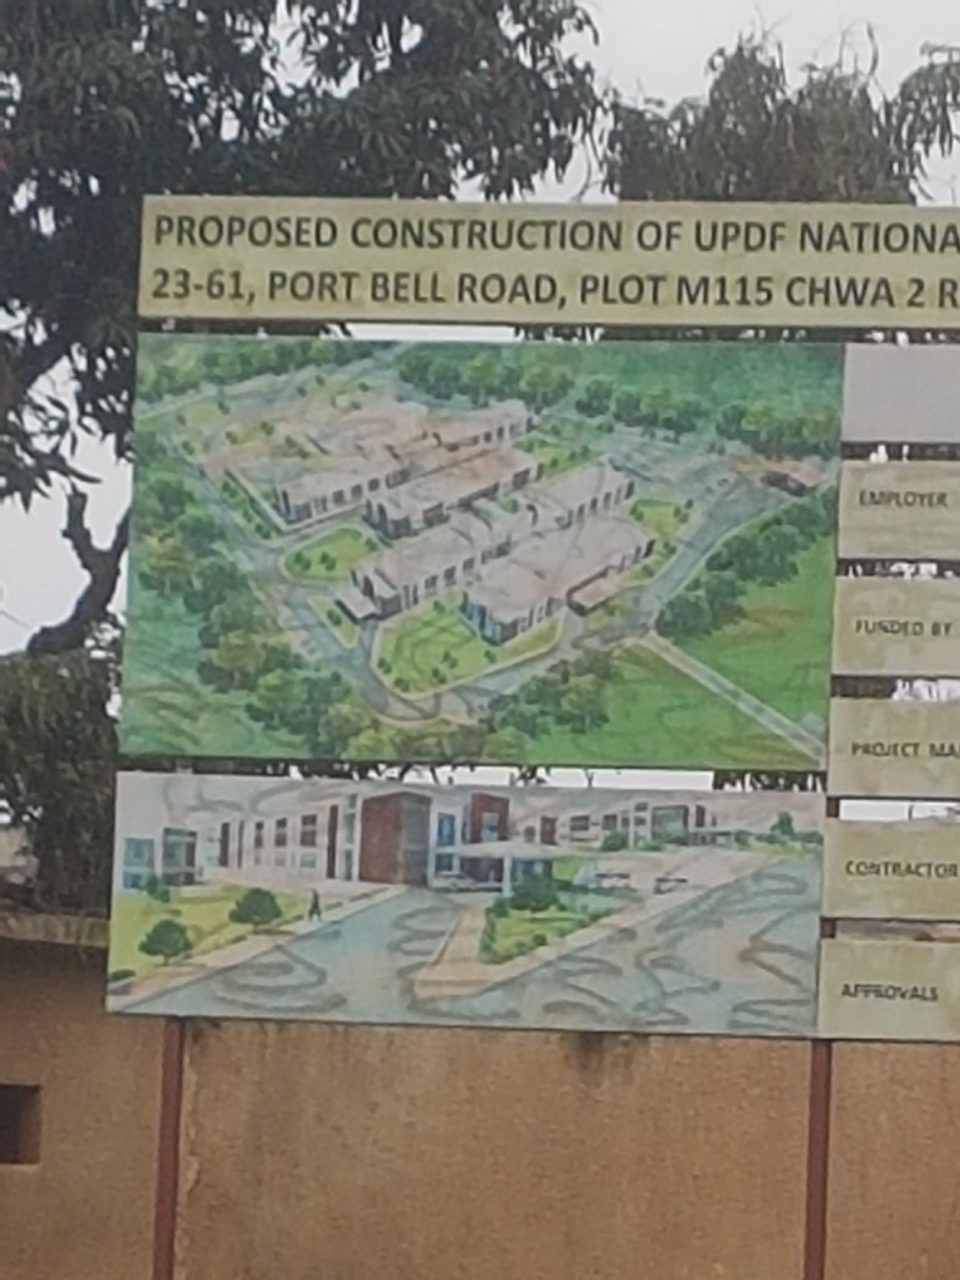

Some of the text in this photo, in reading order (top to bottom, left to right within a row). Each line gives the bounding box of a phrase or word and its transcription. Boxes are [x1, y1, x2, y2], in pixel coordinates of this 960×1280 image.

[155, 215, 337, 248] PROPOSED
[350, 217, 623, 251] CONSTRUCTION
[636, 219, 682, 251] OF
[695, 221, 786, 252] UPDF
[152, 268, 255, 304] 23-61,
[268, 270, 360, 300] PORT
[371, 272, 446, 302] BELL
[457, 272, 566, 310] ROAD,
[580, 274, 667, 305] PLOT
[677, 275, 773, 306] M115
[786, 276, 895, 308] CHWA
[907, 278, 925, 308] 2
[859, 489, 949, 509] EMPLOYER
[856, 618, 952, 637] FUNDED BY
[852, 742, 919, 758] PROJECT
[846, 861, 958, 879] CONTRACTOR
[841, 983, 939, 1001] APPROVALS
